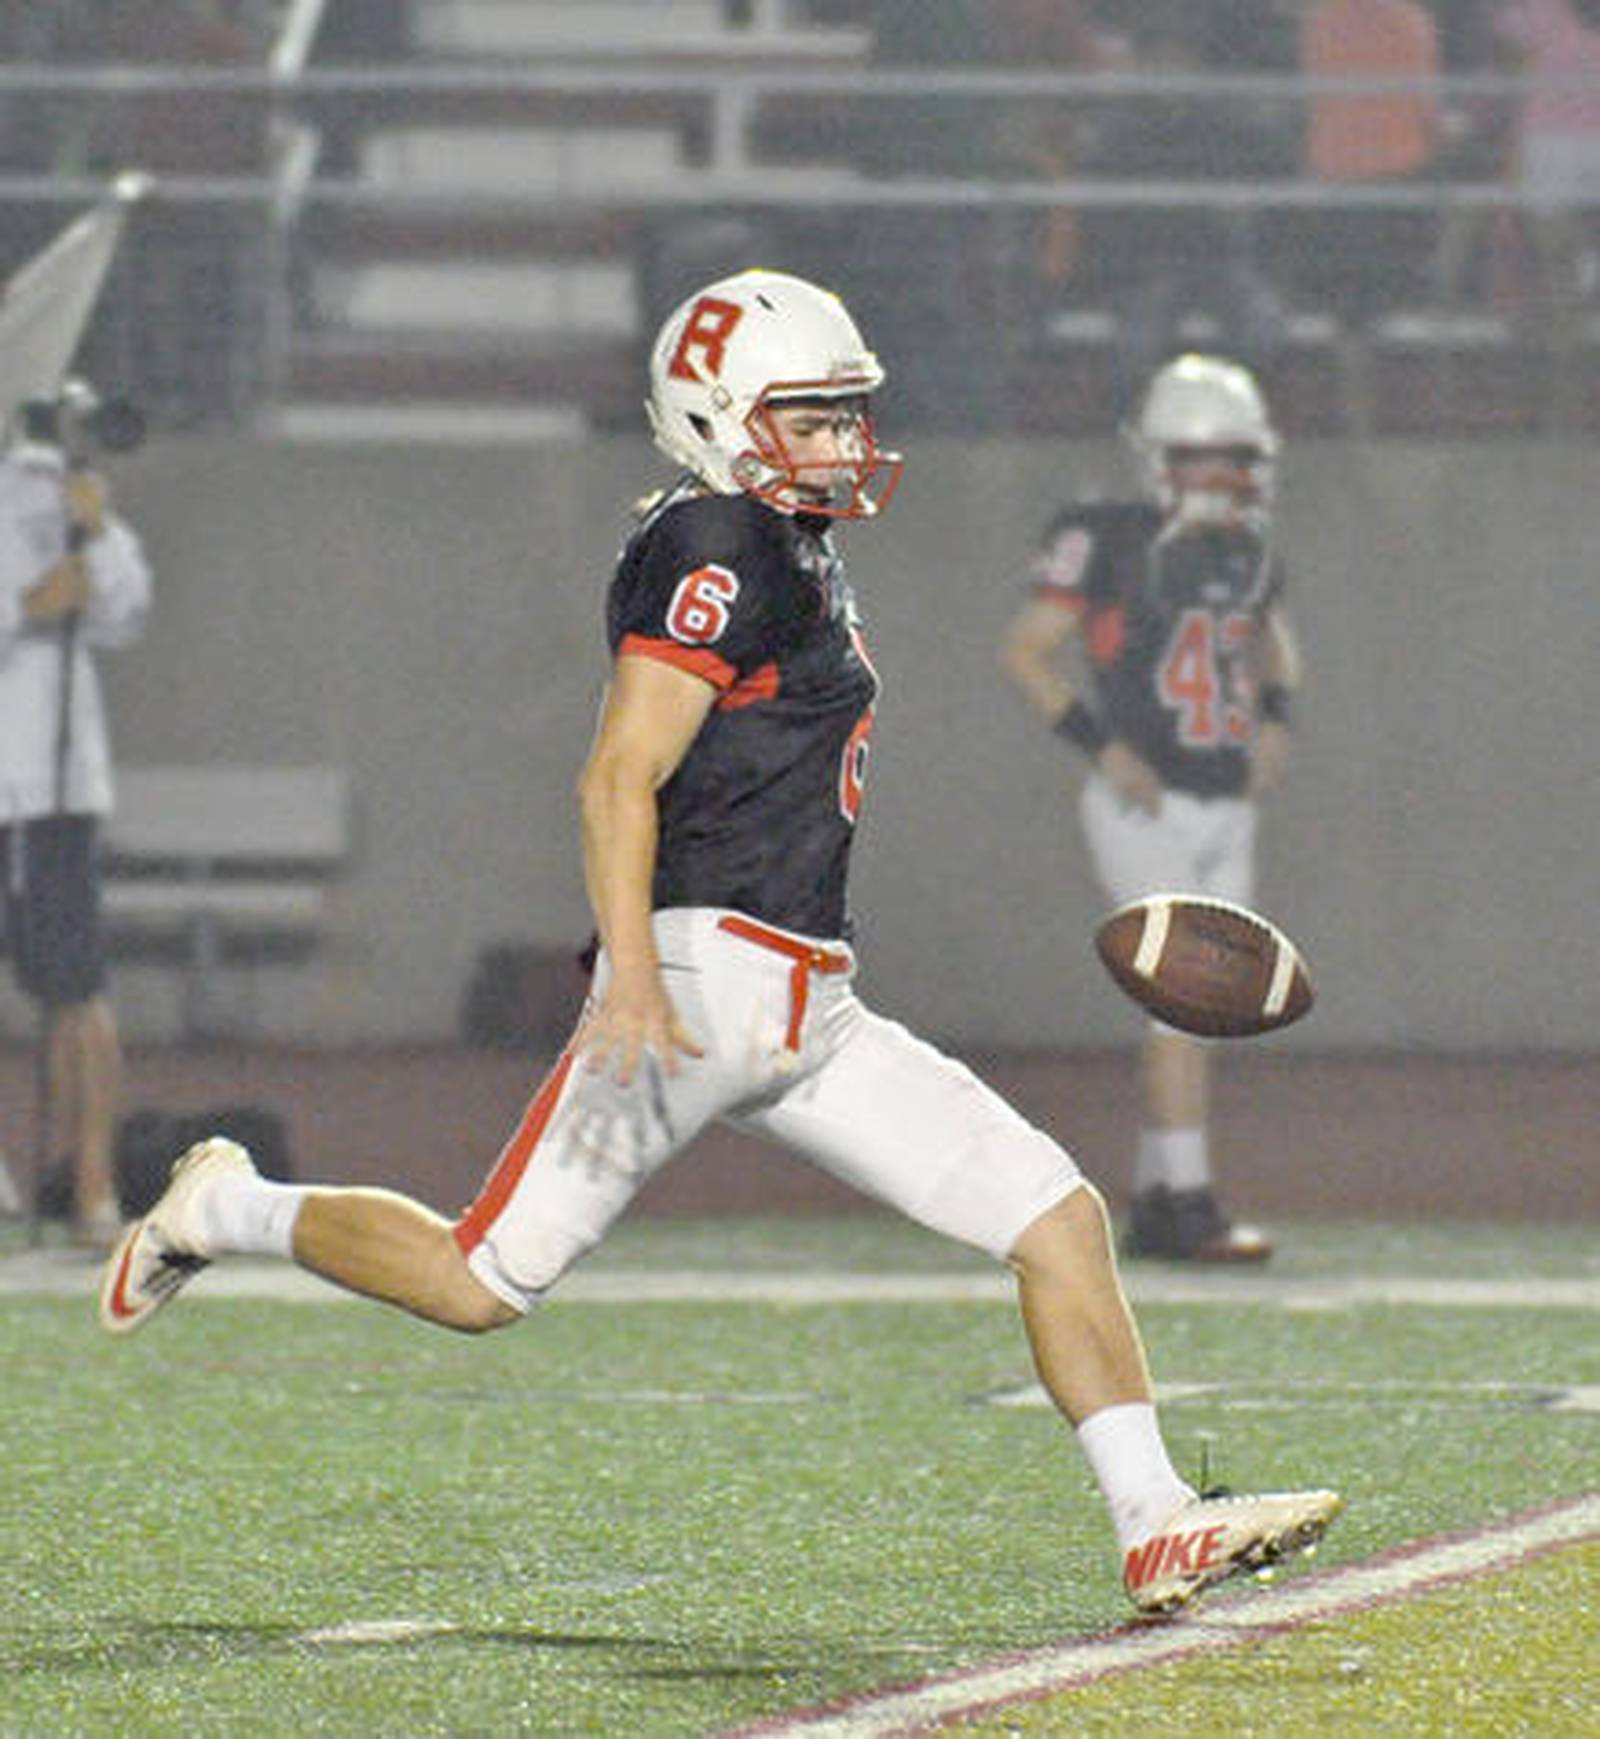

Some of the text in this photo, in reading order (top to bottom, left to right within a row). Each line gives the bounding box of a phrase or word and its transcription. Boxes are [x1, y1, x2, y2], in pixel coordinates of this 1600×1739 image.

[668, 297, 744, 383] R
[665, 563, 740, 644] 6
[1123, 1523, 1228, 1591] NIKE
